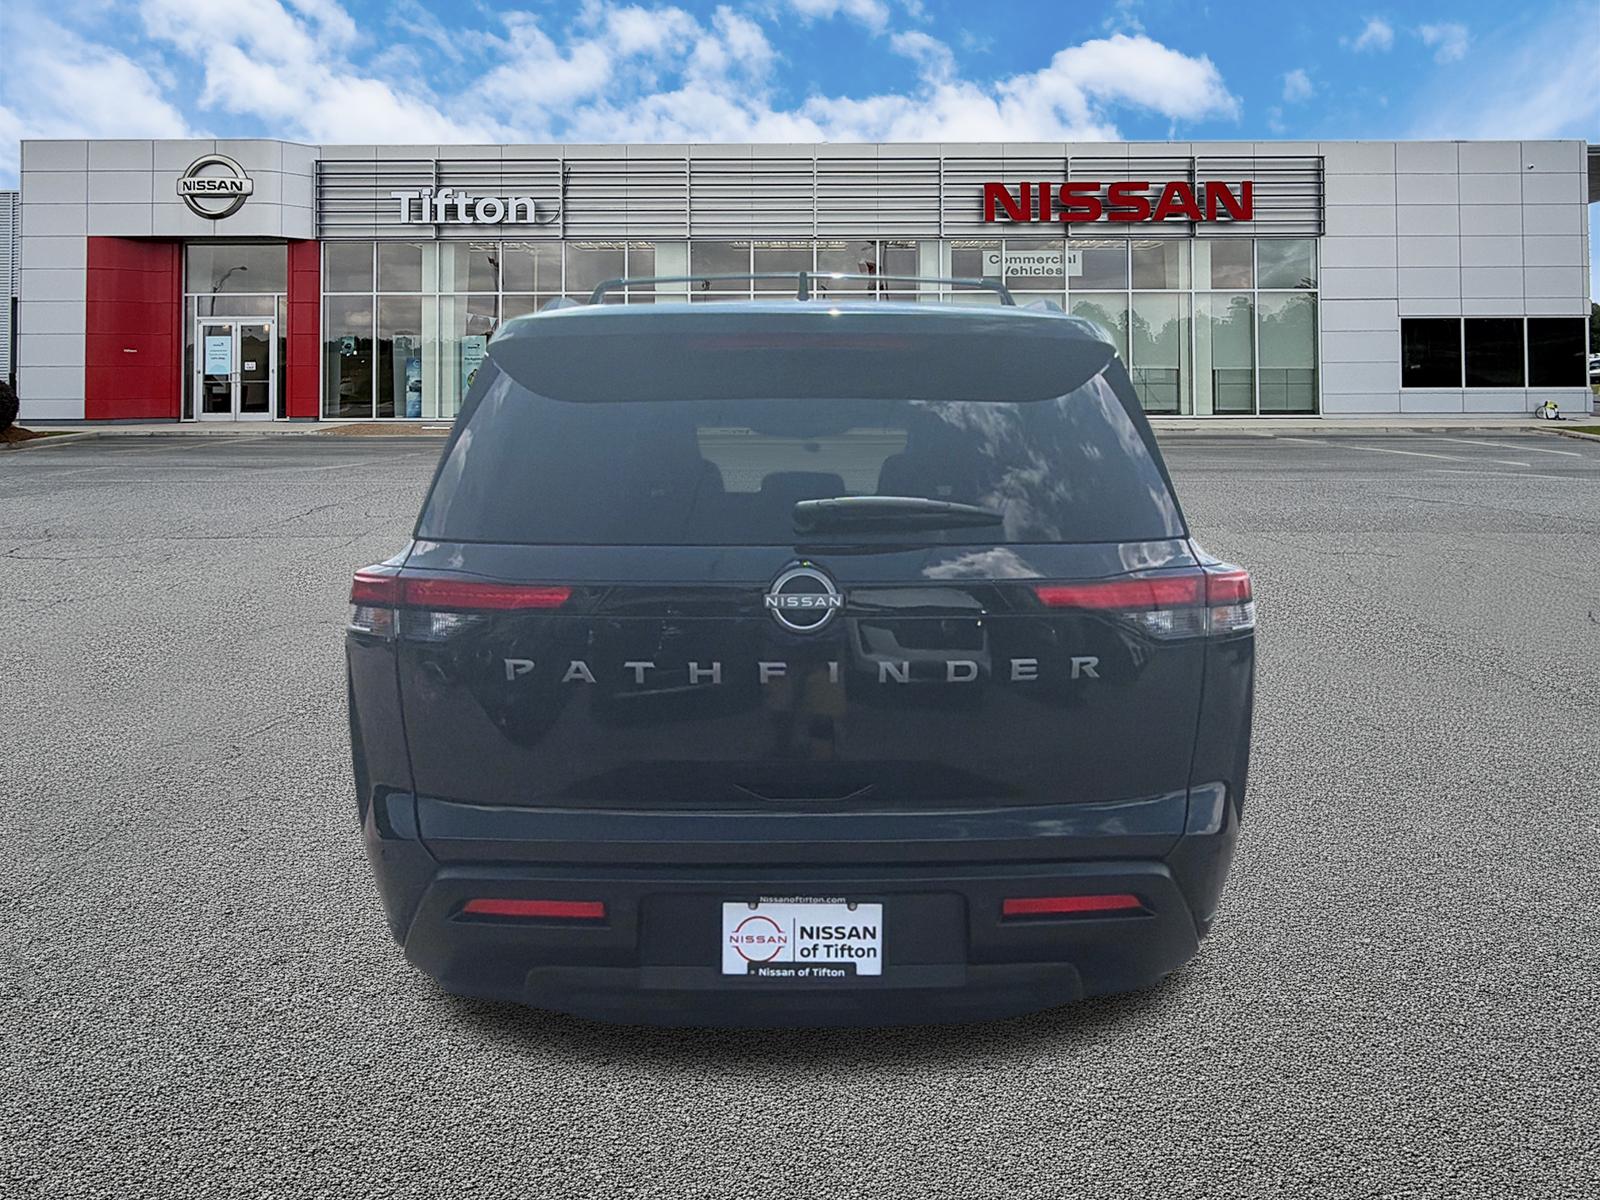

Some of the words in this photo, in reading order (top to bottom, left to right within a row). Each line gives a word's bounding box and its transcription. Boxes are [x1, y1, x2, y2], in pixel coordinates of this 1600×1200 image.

[182, 180, 243, 191] NISSAN
[391, 188, 536, 225] Tifton
[983, 181, 1253, 223] NISSAN
[766, 596, 841, 607] NISSAN
[504, 656, 1100, 684] PATHFINDER
[729, 935, 788, 944] NISSAN
[800, 926, 877, 940] NISSAN
[800, 945, 819, 958] of
[823, 944, 877, 958] Tifton
[758, 968, 795, 977] Nissan
[798, 968, 809, 977] of
[811, 968, 845, 977] Tifton
